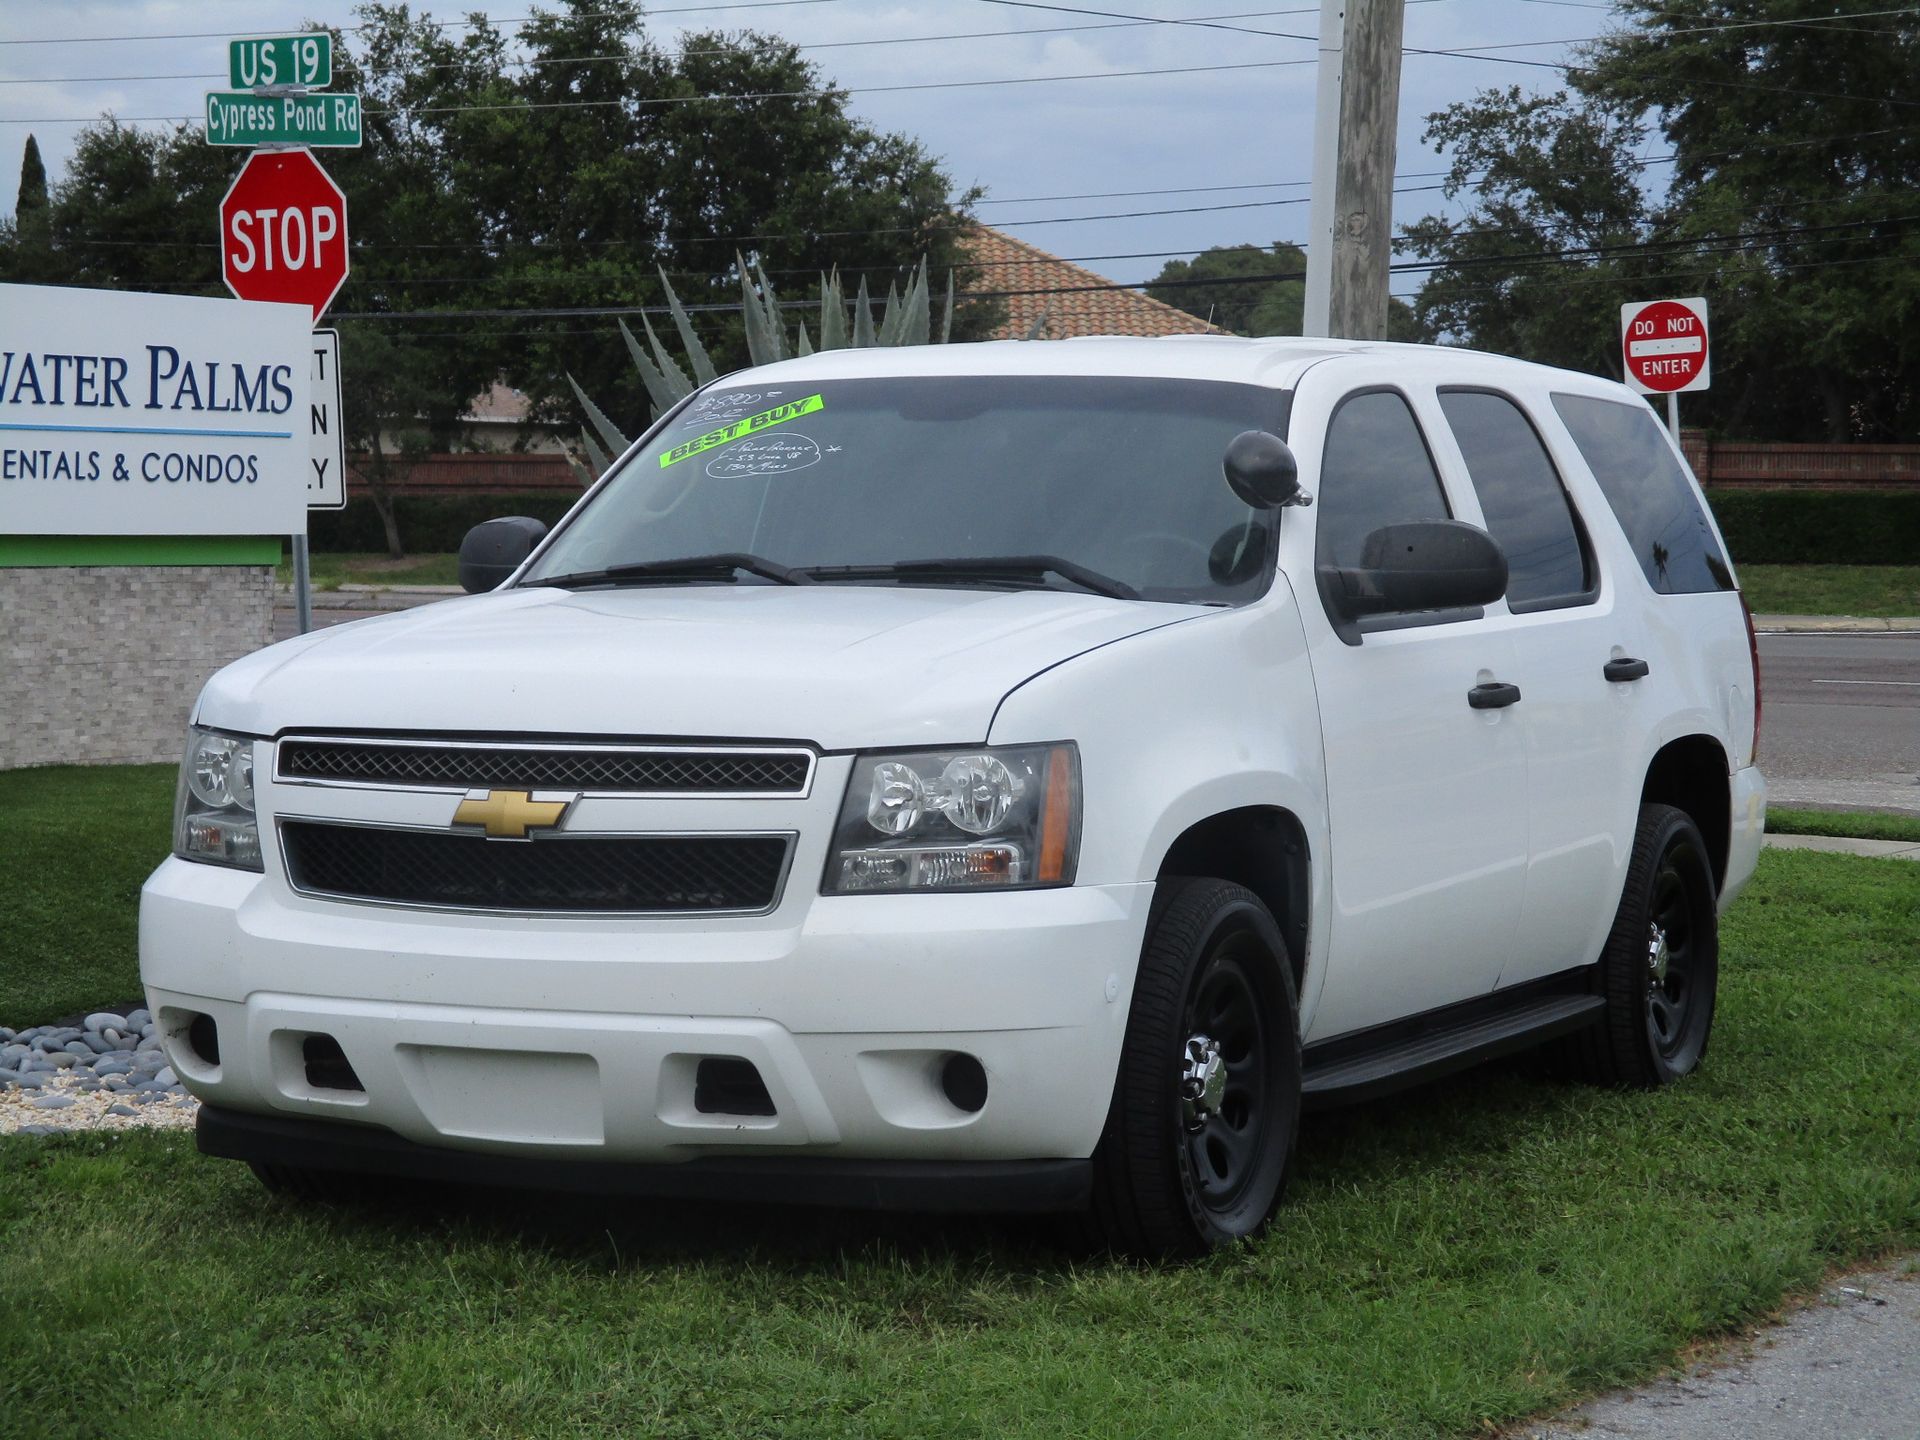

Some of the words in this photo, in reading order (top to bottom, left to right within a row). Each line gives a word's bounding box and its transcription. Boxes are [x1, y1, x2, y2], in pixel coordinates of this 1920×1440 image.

[240, 41, 277, 86] US
[292, 39, 319, 84] 19
[208, 96, 276, 141] Cypress
[284, 98, 326, 132] Pond
[335, 98, 358, 132] Rd
[231, 206, 337, 273] STOP
[1635, 320, 1654, 335] DO
[1667, 317, 1694, 333] NOT
[145, 345, 293, 414] PALMS
[1642, 359, 1690, 376] ENTER
[669, 423, 742, 462] BEST
[750, 399, 813, 429] BUY
[3, 450, 100, 481] ENTALS
[112, 453, 130, 482] &
[141, 453, 258, 483] CONDOS
